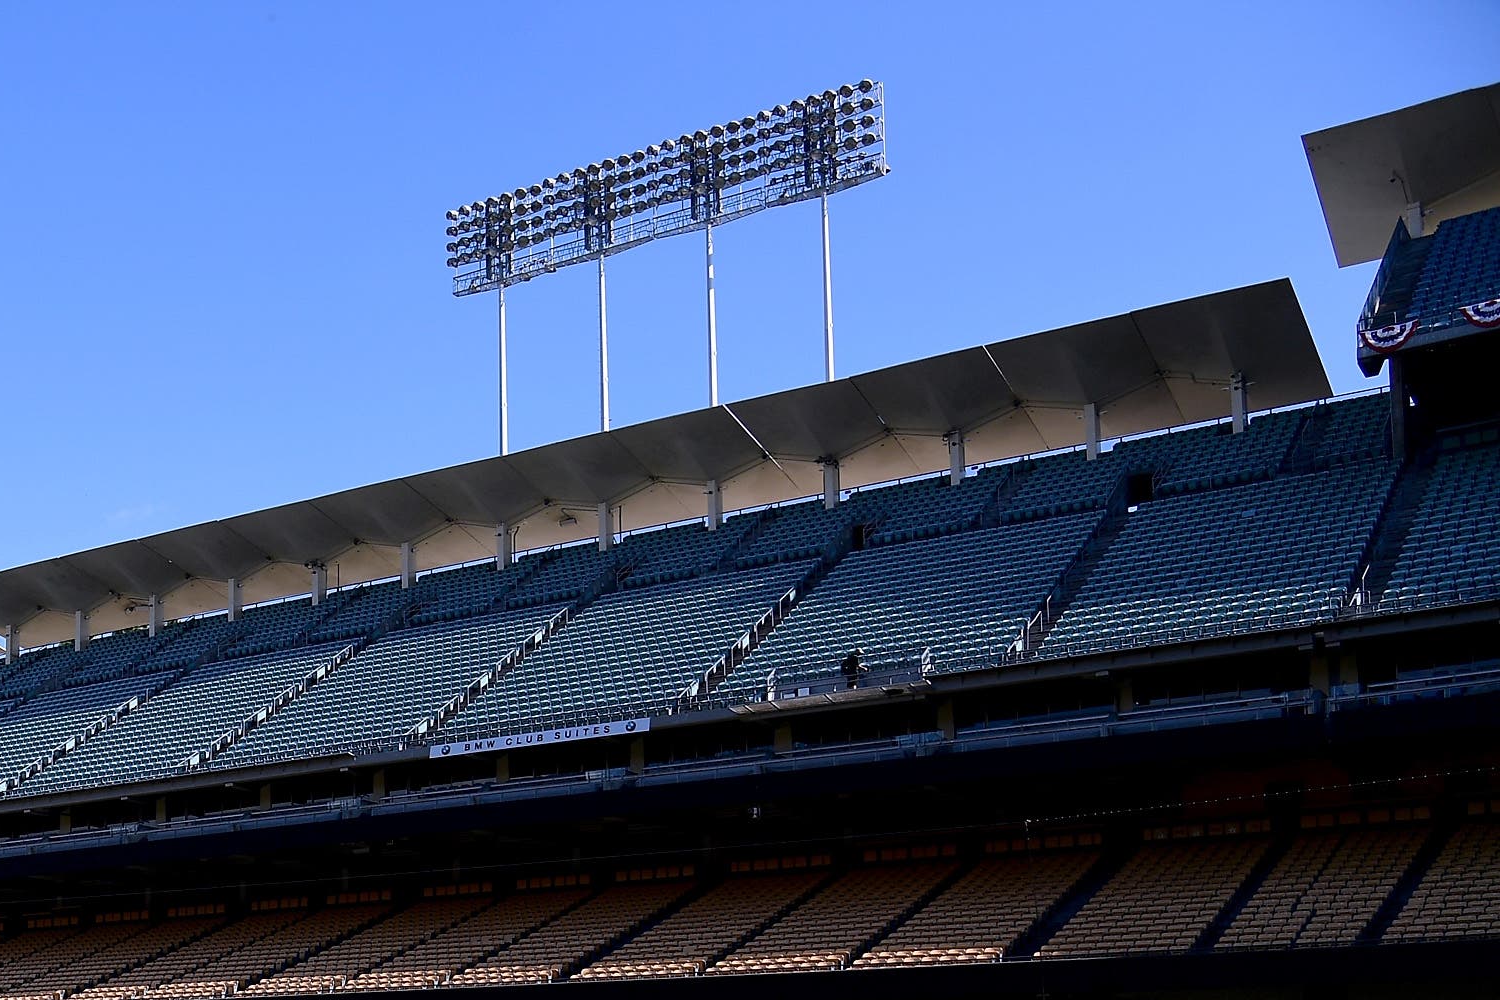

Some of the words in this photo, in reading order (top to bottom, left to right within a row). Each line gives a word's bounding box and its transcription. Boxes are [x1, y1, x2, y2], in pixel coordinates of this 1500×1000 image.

[464, 739, 496, 751] BMW
[505, 734, 544, 746] CLUB
[554, 725, 611, 740] SUITES
